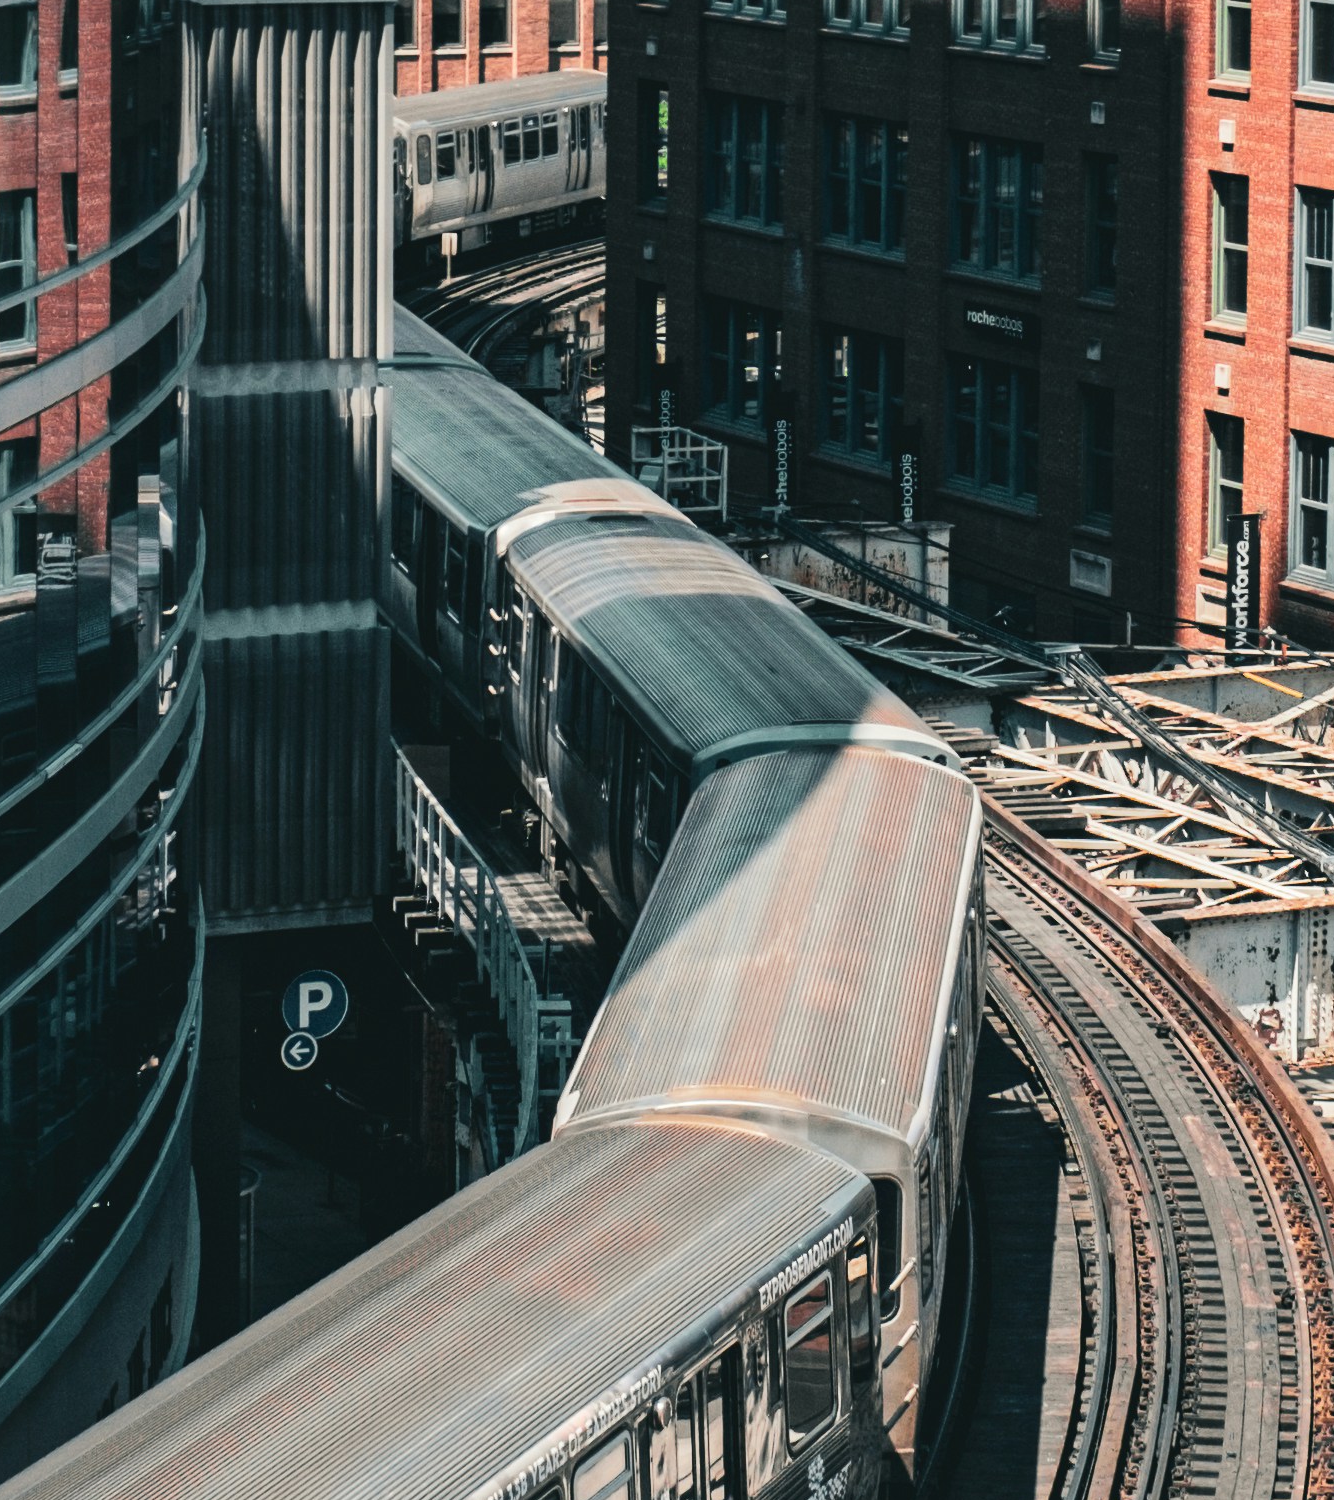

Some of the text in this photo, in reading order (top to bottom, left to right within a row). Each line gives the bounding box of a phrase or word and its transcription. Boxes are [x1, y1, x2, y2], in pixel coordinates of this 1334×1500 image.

[299, 981, 333, 1028] P
[528, 1440, 568, 1488] YEARS
[568, 1426, 584, 1458] OF
